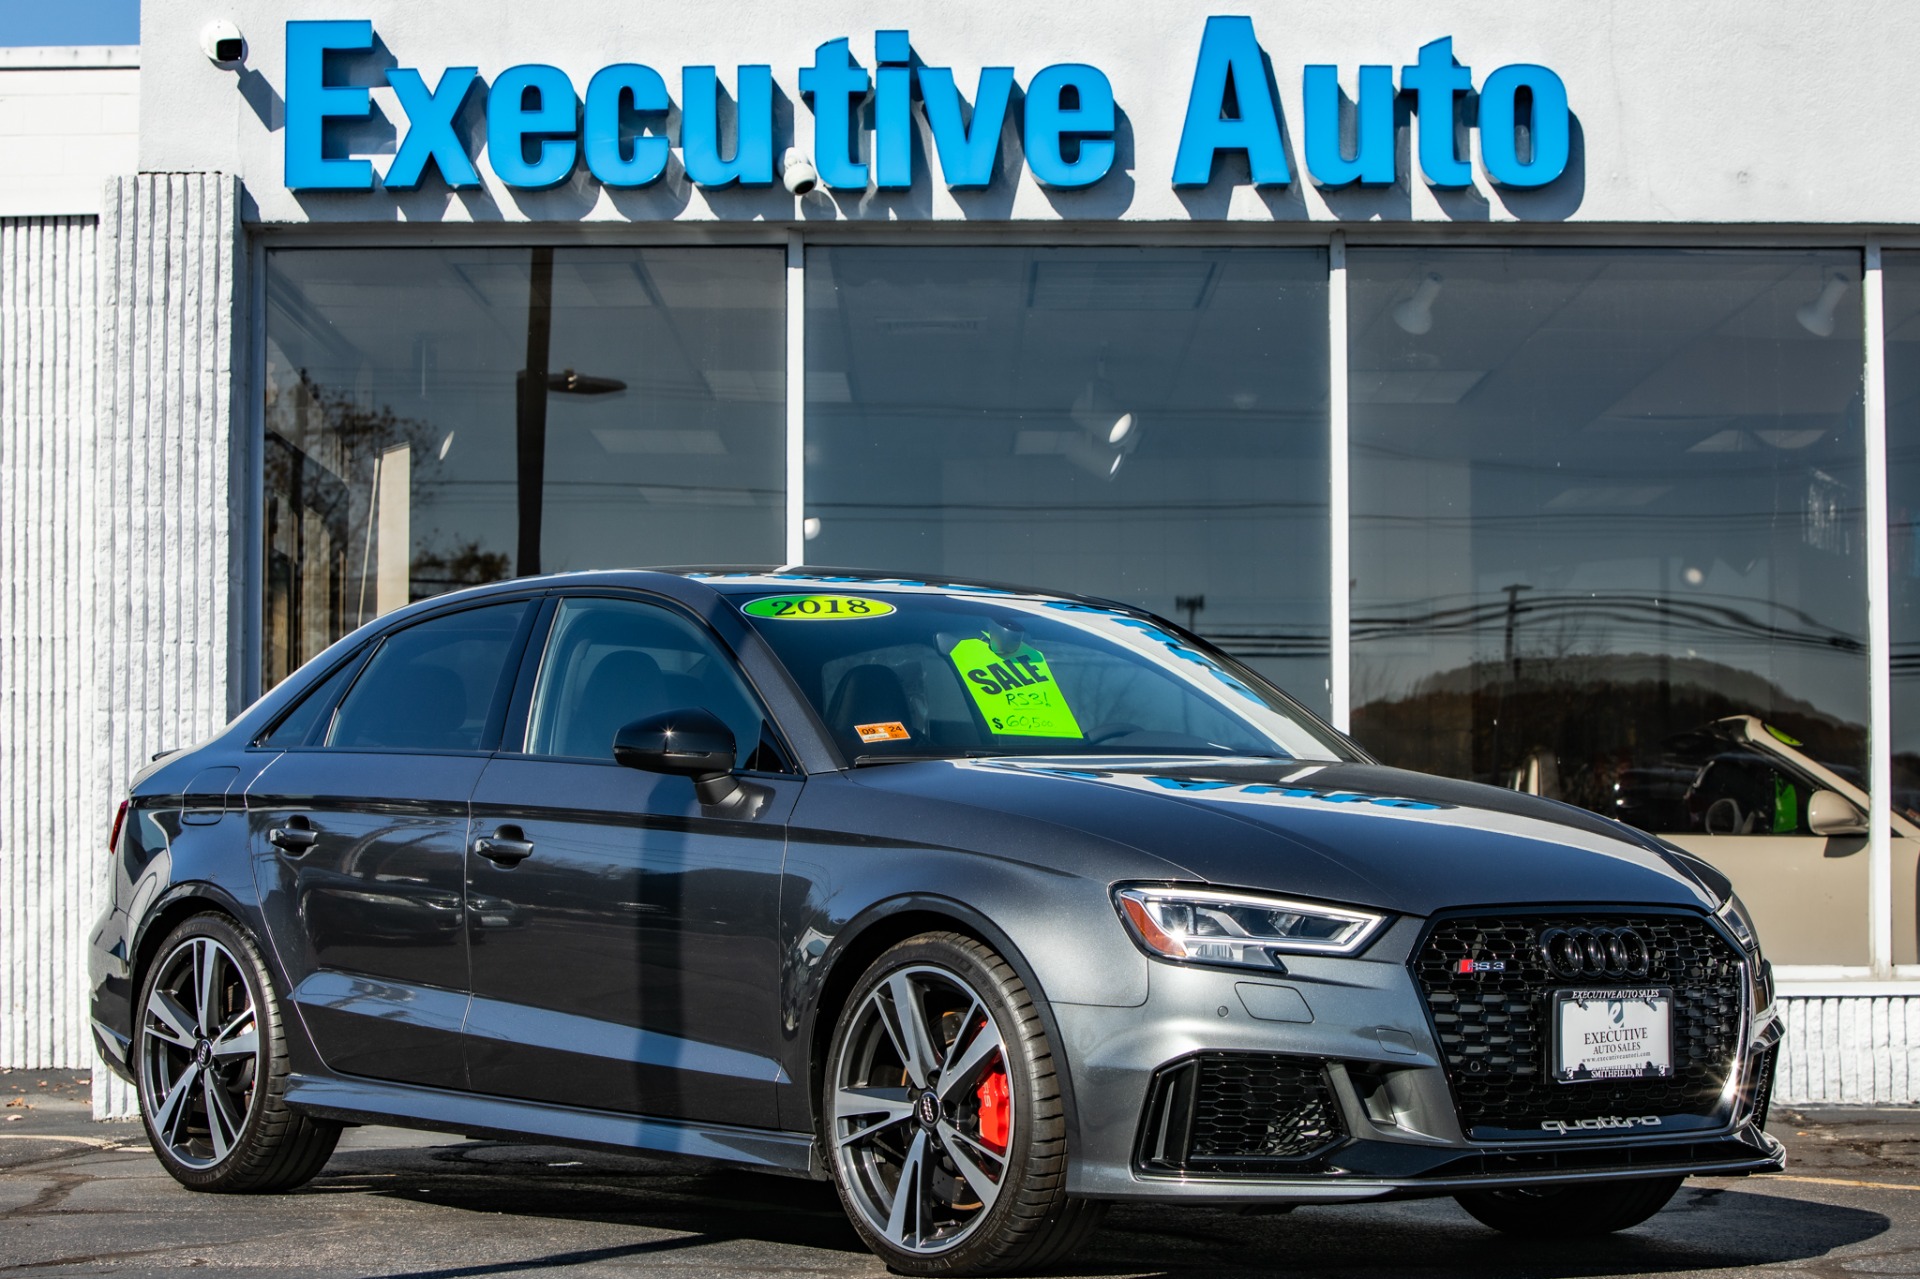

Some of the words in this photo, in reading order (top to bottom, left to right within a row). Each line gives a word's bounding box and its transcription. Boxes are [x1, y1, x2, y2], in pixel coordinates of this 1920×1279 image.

[285, 20, 1115, 191] Executive
[1172, 15, 1569, 190] Auto
[771, 599, 871, 616] 2018
[967, 655, 1050, 695] SALE
[888, 725, 902, 733] 24
[1572, 990, 1616, 999] EXECUTIVE
[1616, 989, 1638, 998] AUTO
[1638, 989, 1660, 998] SALES
[1584, 1027, 1648, 1045] EXECUTIVE
[1593, 1044, 1617, 1055] AUTO
[1617, 1041, 1641, 1052] SALES
[1591, 1069, 1635, 1078] SMITHFIELD,
[1635, 1068, 1643, 1077] RI
[1541, 1115, 1662, 1135] quattro
